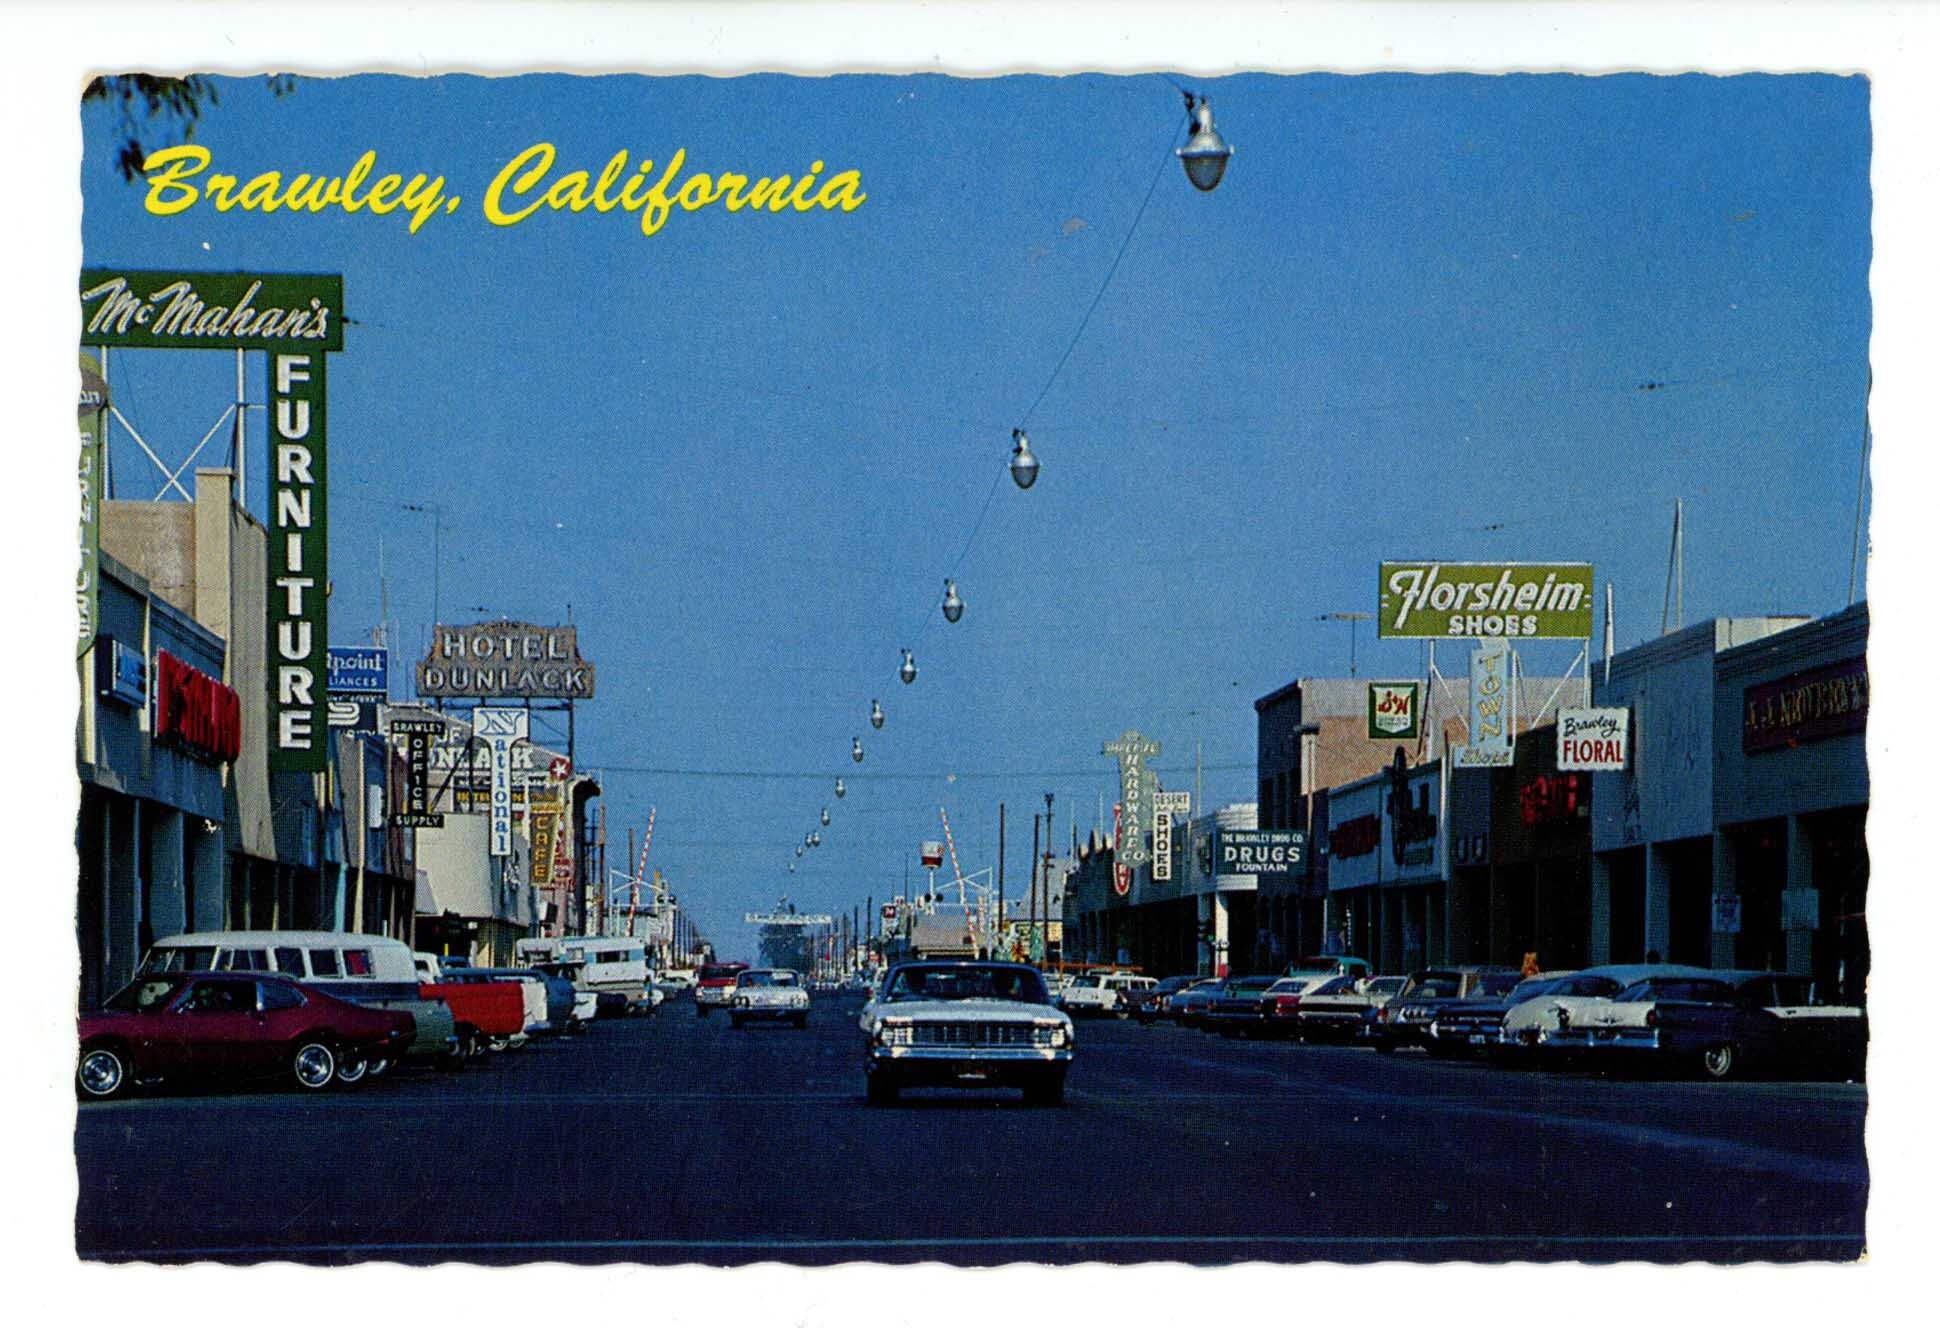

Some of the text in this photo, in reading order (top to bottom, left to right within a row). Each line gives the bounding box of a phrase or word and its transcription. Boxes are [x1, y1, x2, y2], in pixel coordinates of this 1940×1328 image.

[276, 354, 315, 750] FURNITURE
[1388, 564, 1586, 630] Florsheim
[1448, 614, 1538, 636] SHOES
[442, 632, 569, 660] HOTEL
[424, 666, 586, 691] DUNLACK
[393, 722, 442, 733] BRAWLEY
[1564, 716, 1622, 738] Brawley
[1563, 740, 1624, 764] FLORAL
[412, 738, 424, 812] OFFICE
[1126, 754, 1140, 849] HARDWARE
[395, 815, 440, 826] SUPPLY
[533, 816, 550, 877] CAFE
[1157, 814, 1169, 877] SHOES
[1224, 846, 1301, 862] DRUGS
[1236, 863, 1288, 872] FOUNTAIN
